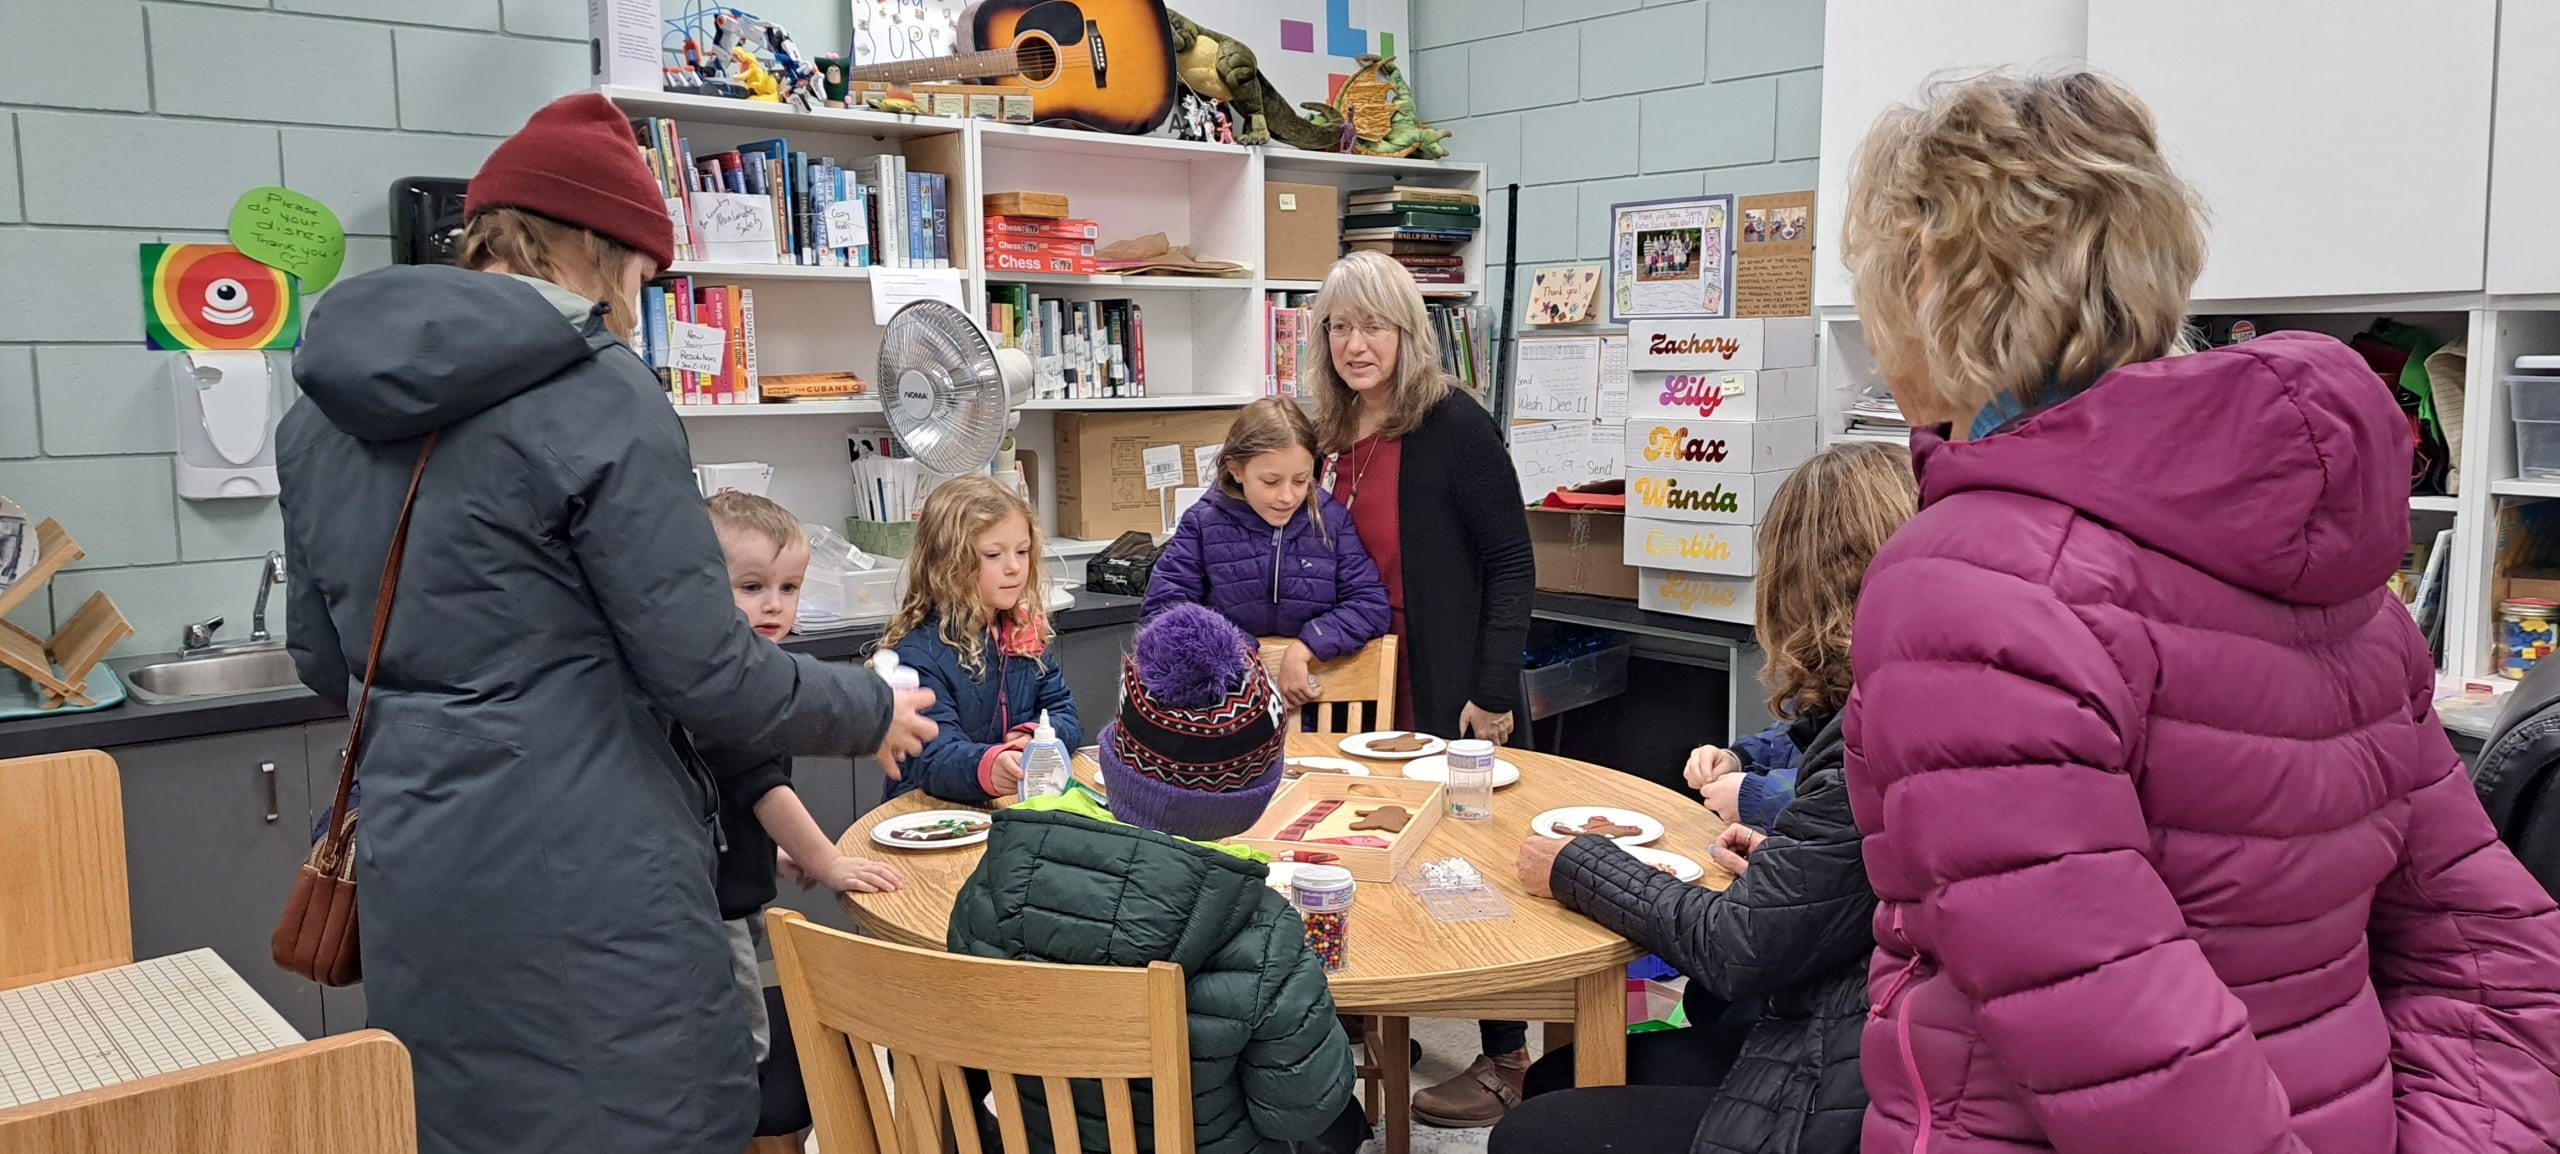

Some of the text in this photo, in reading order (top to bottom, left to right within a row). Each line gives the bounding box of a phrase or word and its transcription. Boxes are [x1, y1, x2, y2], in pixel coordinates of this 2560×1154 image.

[265, 192, 318, 216] Please
[247, 203, 320, 227] do your
[934, 208, 946, 241] EAST
[998, 222, 1021, 232] Chess
[250, 231, 296, 252] Thank
[998, 241, 1021, 250] Chess
[998, 254, 1041, 270] Chess
[1543, 283, 1582, 299] Thank you!
[745, 306, 756, 369] BOUNDARIES
[1649, 333, 1740, 360] Zachary
[806, 385, 848, 393] CUBANS
[1516, 374, 1533, 387] Send
[904, 391, 928, 400] NOMA
[1549, 396, 1572, 412] Dec
[1659, 375, 1724, 417] Lily
[1643, 425, 1728, 463] Max
[1525, 460, 1556, 477] Dec
[1561, 459, 1574, 472] 19
[1587, 456, 1614, 475] Send
[1634, 476, 1738, 513] Wanda
[1659, 571, 1737, 612] Lyric
